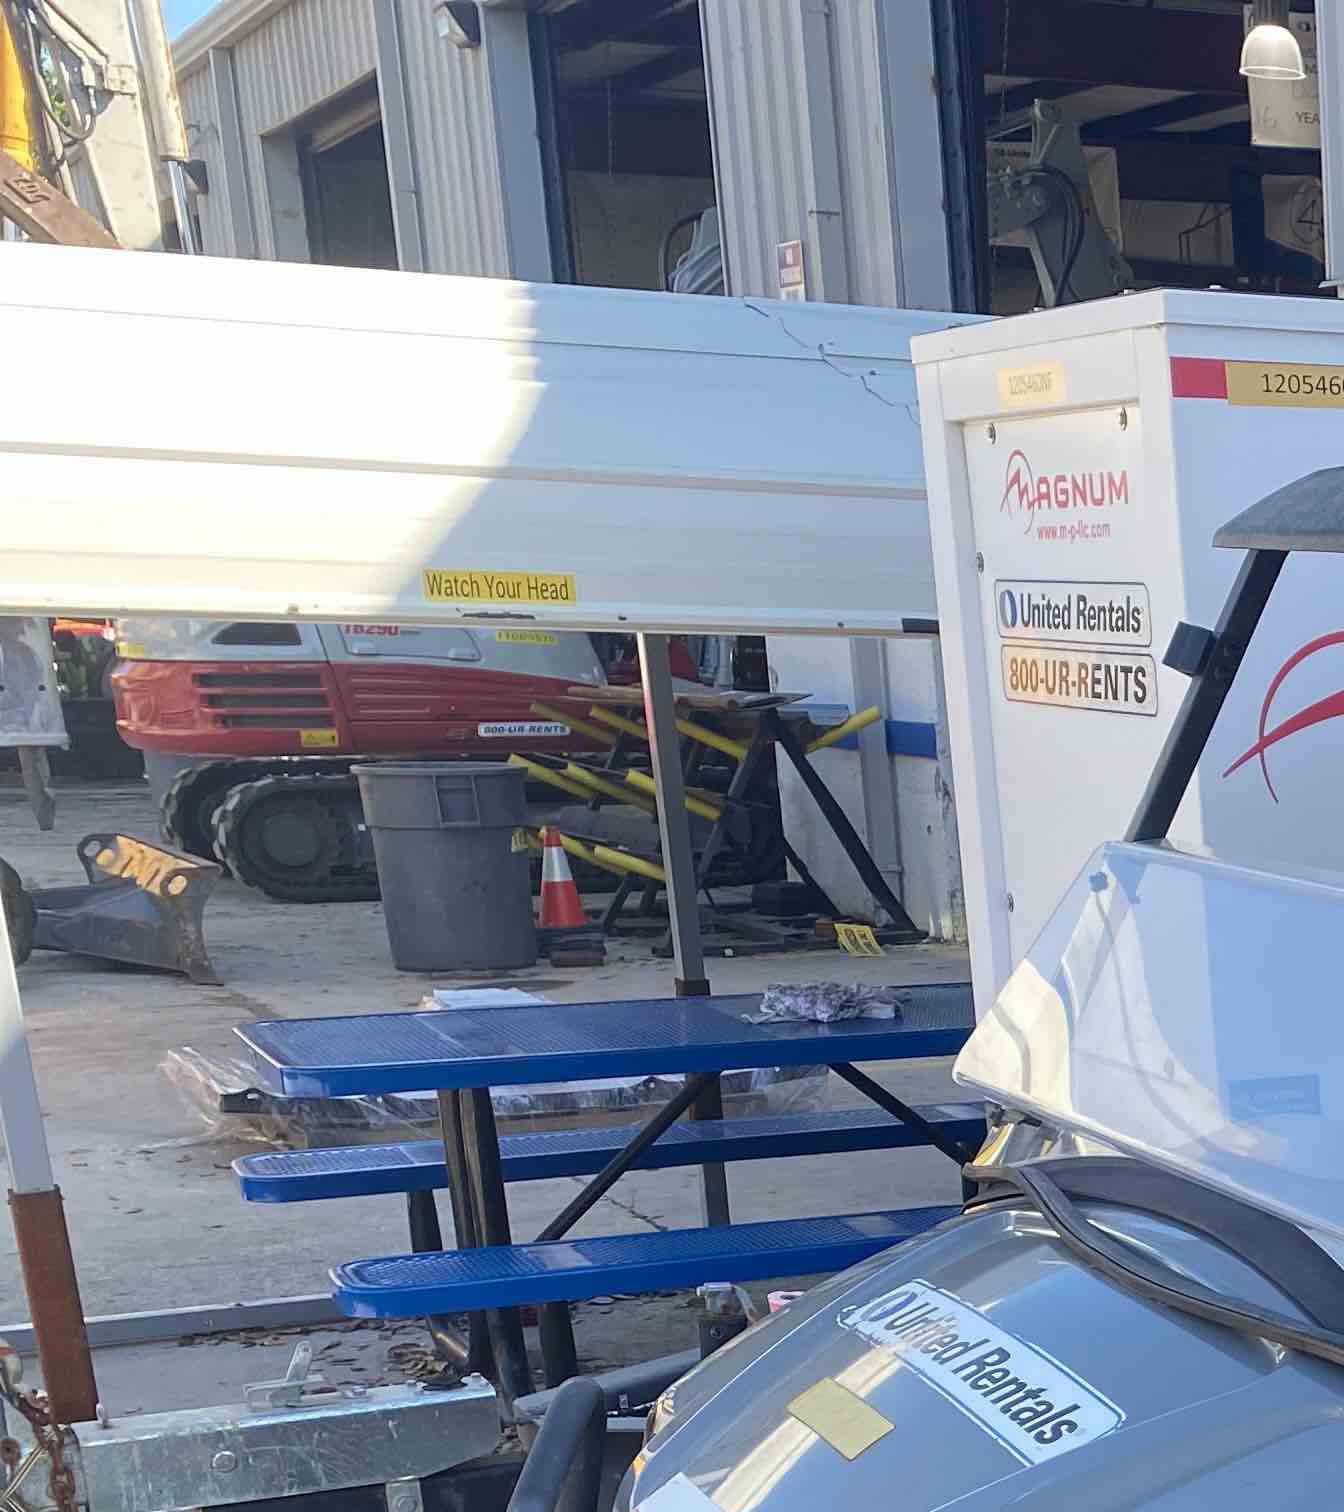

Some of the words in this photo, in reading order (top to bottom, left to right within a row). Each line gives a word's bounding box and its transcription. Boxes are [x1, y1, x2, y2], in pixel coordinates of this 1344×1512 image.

[1000, 466, 1129, 511] MAGNUM
[426, 573, 480, 598] Watch
[484, 574, 523, 599] Your
[528, 576, 569, 601] Head
[1020, 592, 1072, 630] United
[1076, 594, 1142, 633] Rentals
[1009, 655, 1147, 704] 800-UR-RENTS
[884, 1301, 990, 1365] United
[952, 1346, 1081, 1445] Rentals
